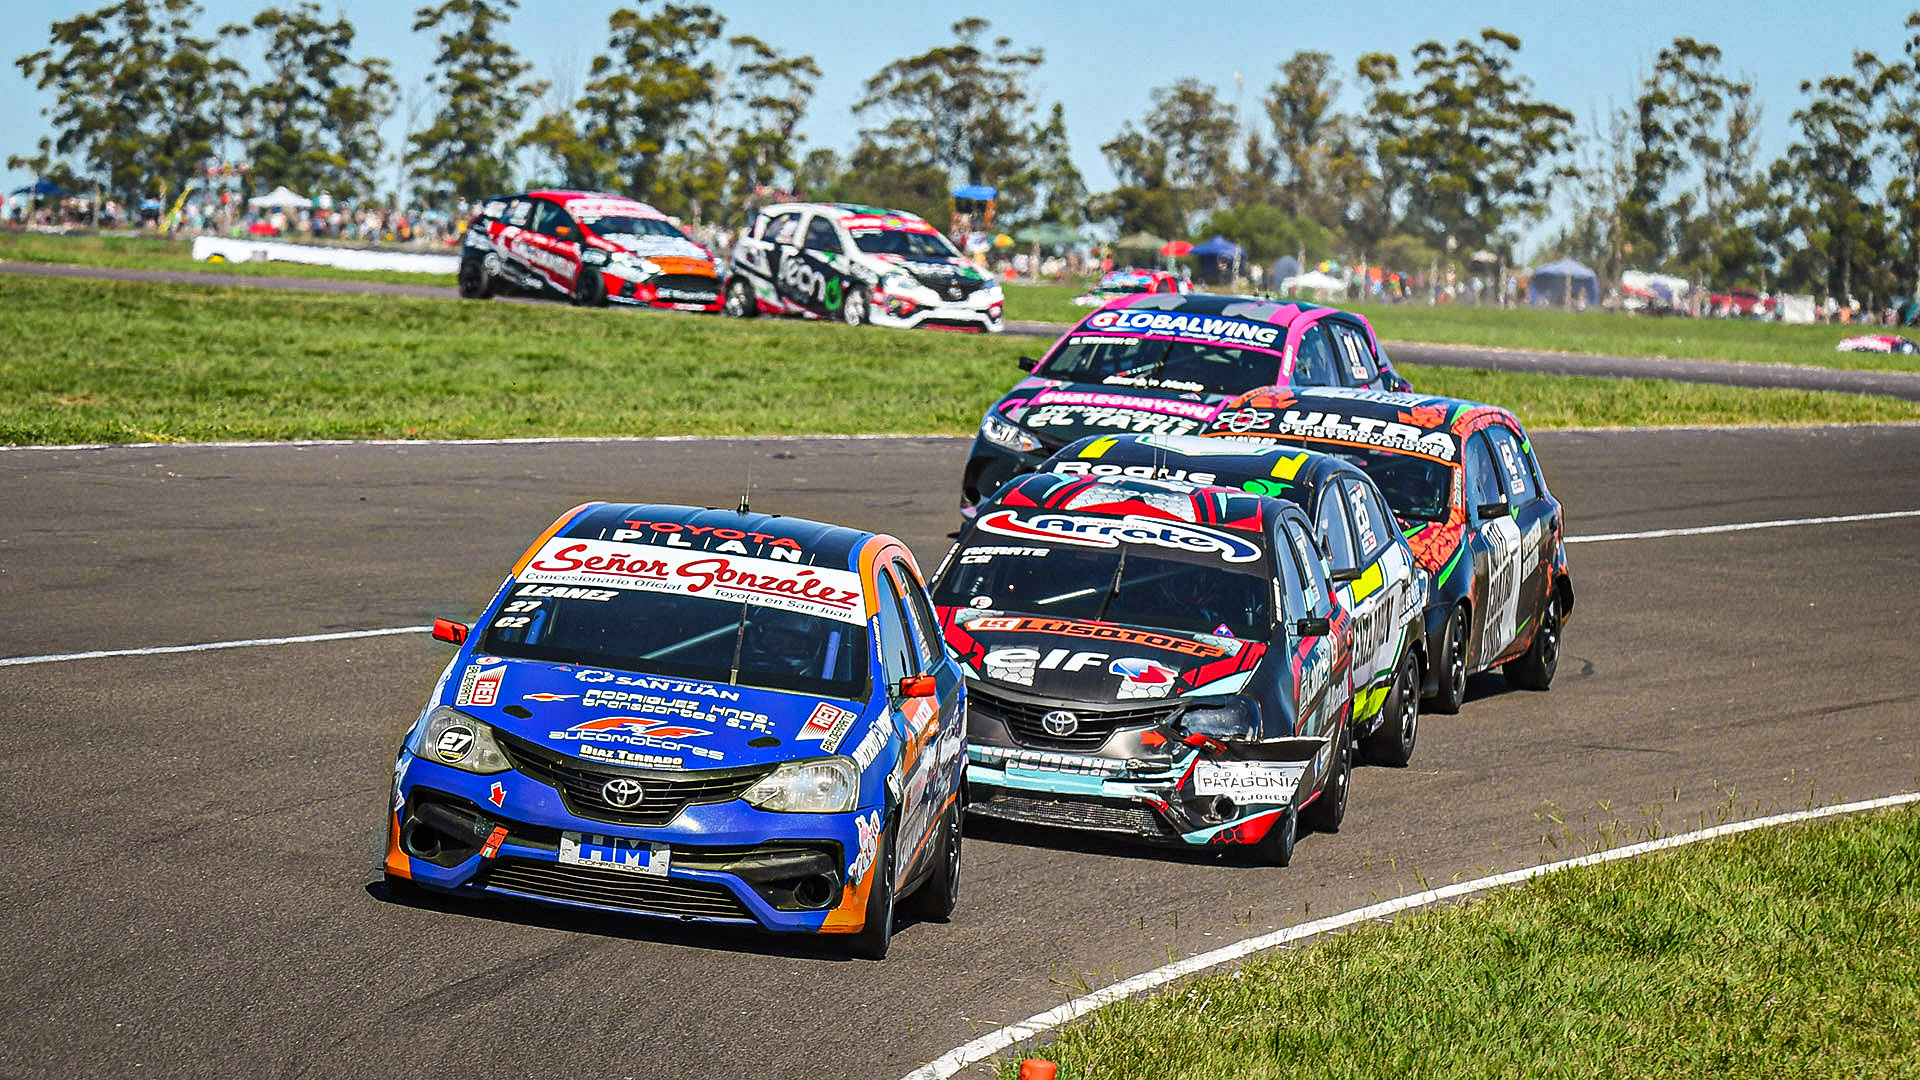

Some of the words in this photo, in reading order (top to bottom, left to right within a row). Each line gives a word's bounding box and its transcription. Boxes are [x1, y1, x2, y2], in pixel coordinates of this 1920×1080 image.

[1091, 312, 1279, 343] GLOBALWING
[1282, 410, 1456, 448] ULTRA
[624, 519, 802, 550] TOYOTA
[525, 572, 632, 587] Concesionario
[634, 579, 682, 591] Oficial
[531, 544, 669, 576] Señor
[677, 559, 861, 607] González
[515, 584, 620, 602] LEANEZ
[714, 588, 759, 601] Toyota
[765, 597, 783, 606] en
[786, 600, 814, 611] San
[818, 606, 852, 619] Juan
[504, 600, 543, 613] 27
[494, 616, 531, 628] C2
[473, 681, 497, 702] RED
[585, 689, 700, 711] RODRIGUEZ
[615, 676, 670, 691] SAN
[672, 681, 741, 702] JUAN
[437, 731, 473, 751] 27
[548, 730, 725, 761] automotores
[579, 744, 615, 758] DIAZ
[616, 750, 683, 765] TERRADO
[1202, 776, 1300, 788] PATAGONIA
[578, 834, 652, 867] HM
